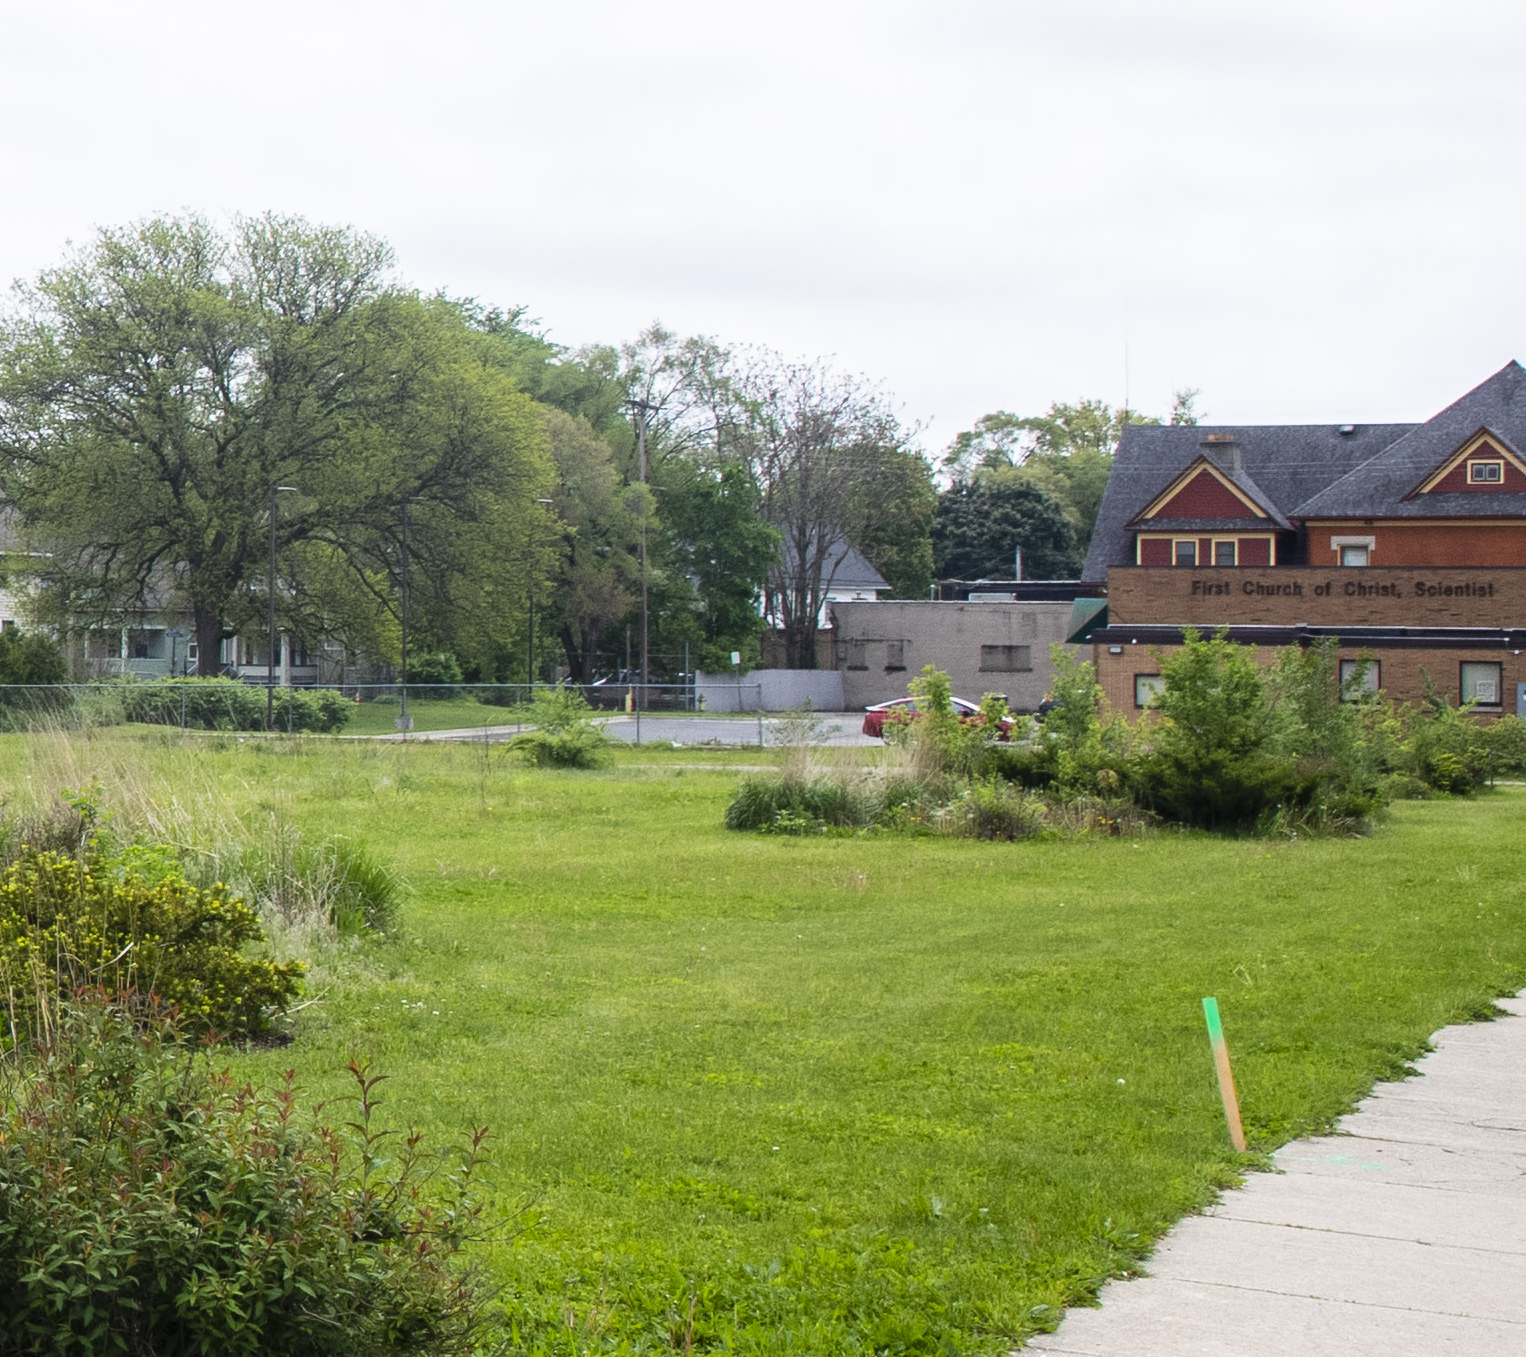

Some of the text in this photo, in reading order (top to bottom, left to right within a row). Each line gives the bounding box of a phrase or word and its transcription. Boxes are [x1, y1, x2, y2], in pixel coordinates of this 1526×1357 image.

[1191, 580, 1495, 598] First Church of Christ, Scientist
